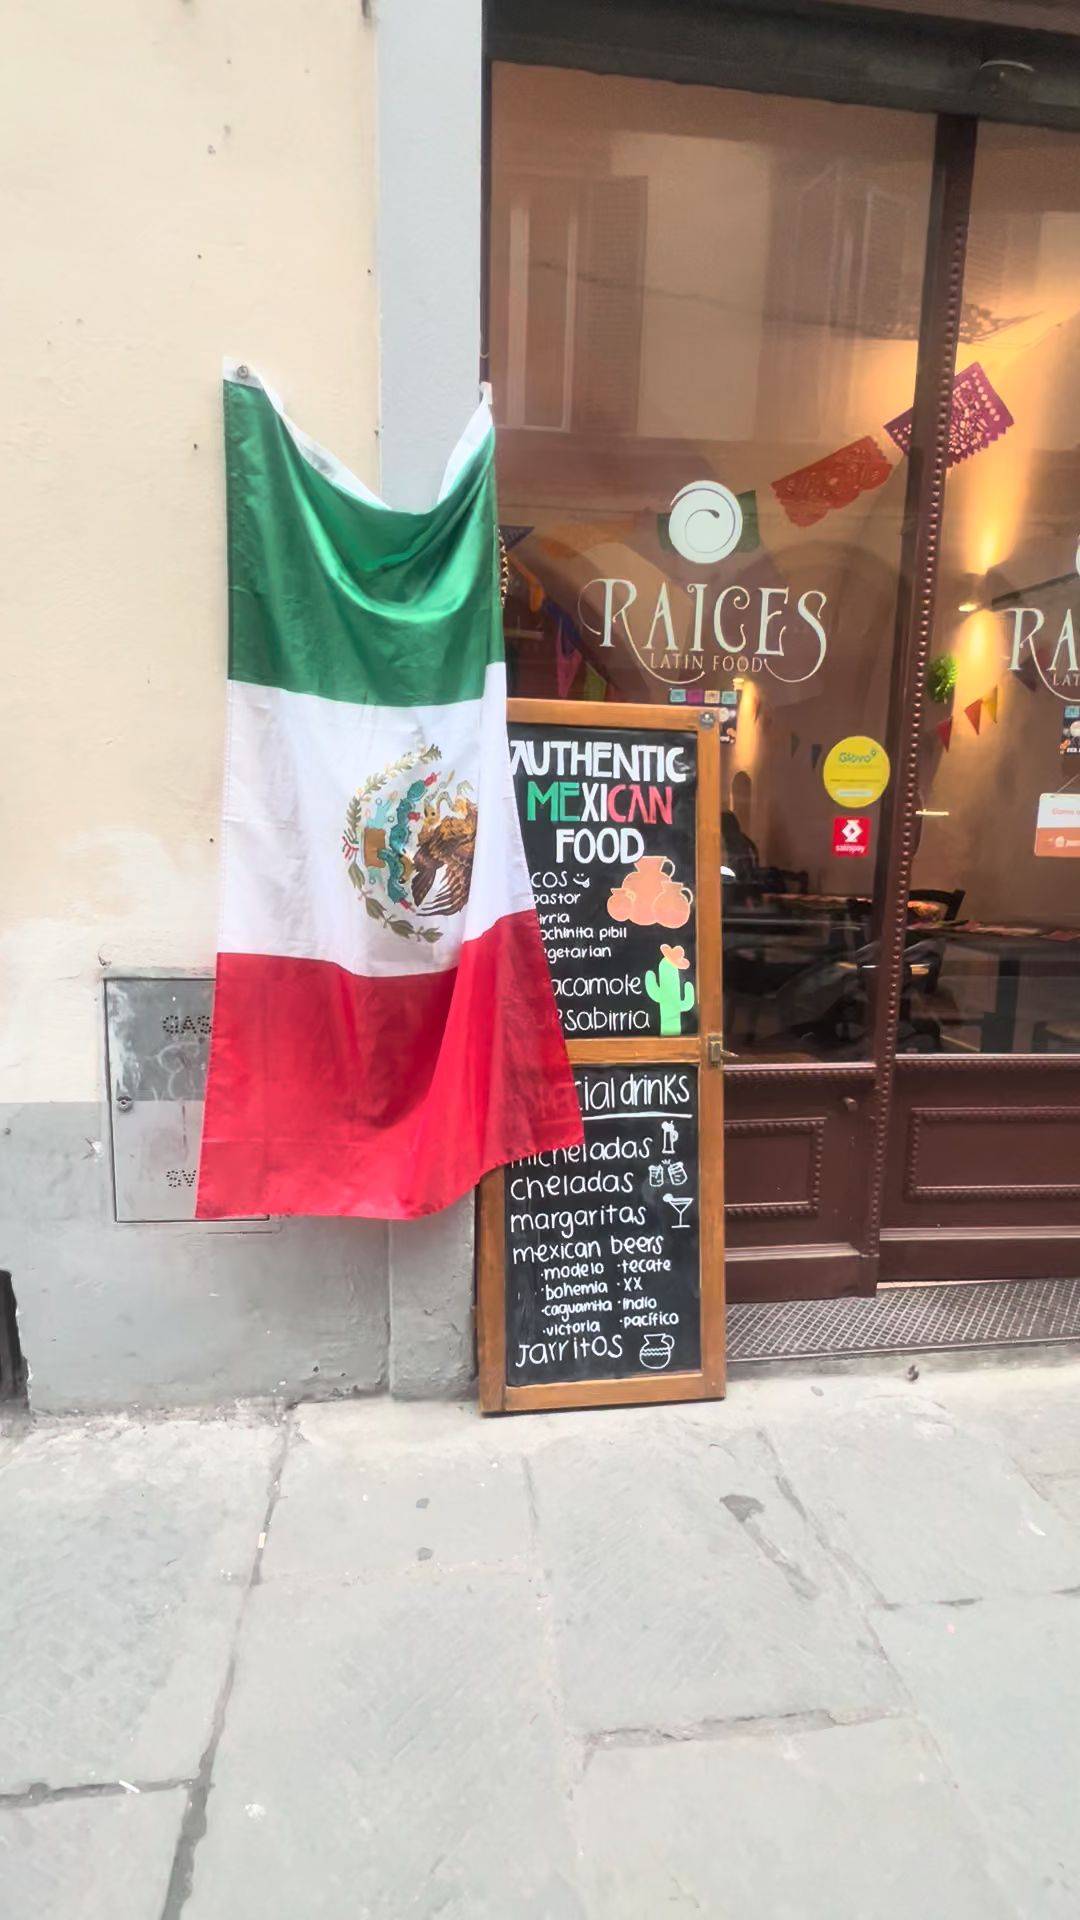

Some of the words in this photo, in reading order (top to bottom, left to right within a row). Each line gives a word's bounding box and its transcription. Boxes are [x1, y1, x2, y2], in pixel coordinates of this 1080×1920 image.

[578, 578, 827, 684] RAICES
[651, 653, 704, 669] LATIN
[713, 655, 763, 673] FOOD
[1003, 607, 1080, 700] RA
[1053, 673, 1080, 687] LAT
[510, 740, 688, 783] AUTHENTIC
[527, 781, 673, 825] MEXICAN
[556, 828, 645, 864] FOOD
[600, 928, 627, 941] pibil
[163, 1016, 212, 1034] GAS
[511, 1170, 634, 1201] cheladas
[511, 1205, 647, 1239] margaritas
[513, 1240, 601, 1264] mexican
[611, 1235, 664, 1255] beers
